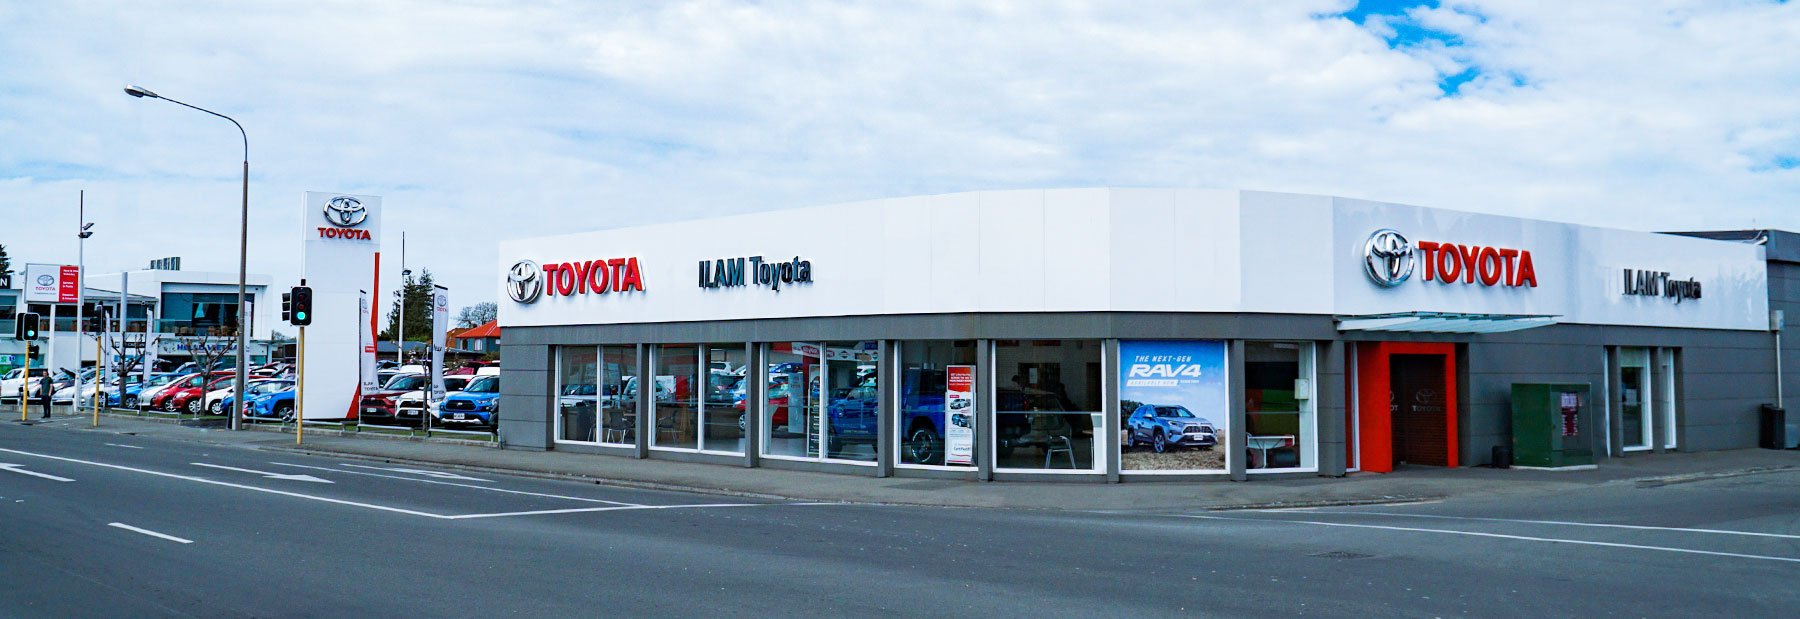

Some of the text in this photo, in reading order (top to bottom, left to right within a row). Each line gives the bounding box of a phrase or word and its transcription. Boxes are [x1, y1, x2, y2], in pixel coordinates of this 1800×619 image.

[318, 227, 371, 240] TOYOTA
[542, 257, 643, 296] TOYOTA
[699, 256, 813, 292] ILAM Toyota
[1418, 241, 1537, 287] TOYOTA
[1623, 269, 1702, 305] ILAM Toyota
[1129, 364, 1202, 377] RAV4
